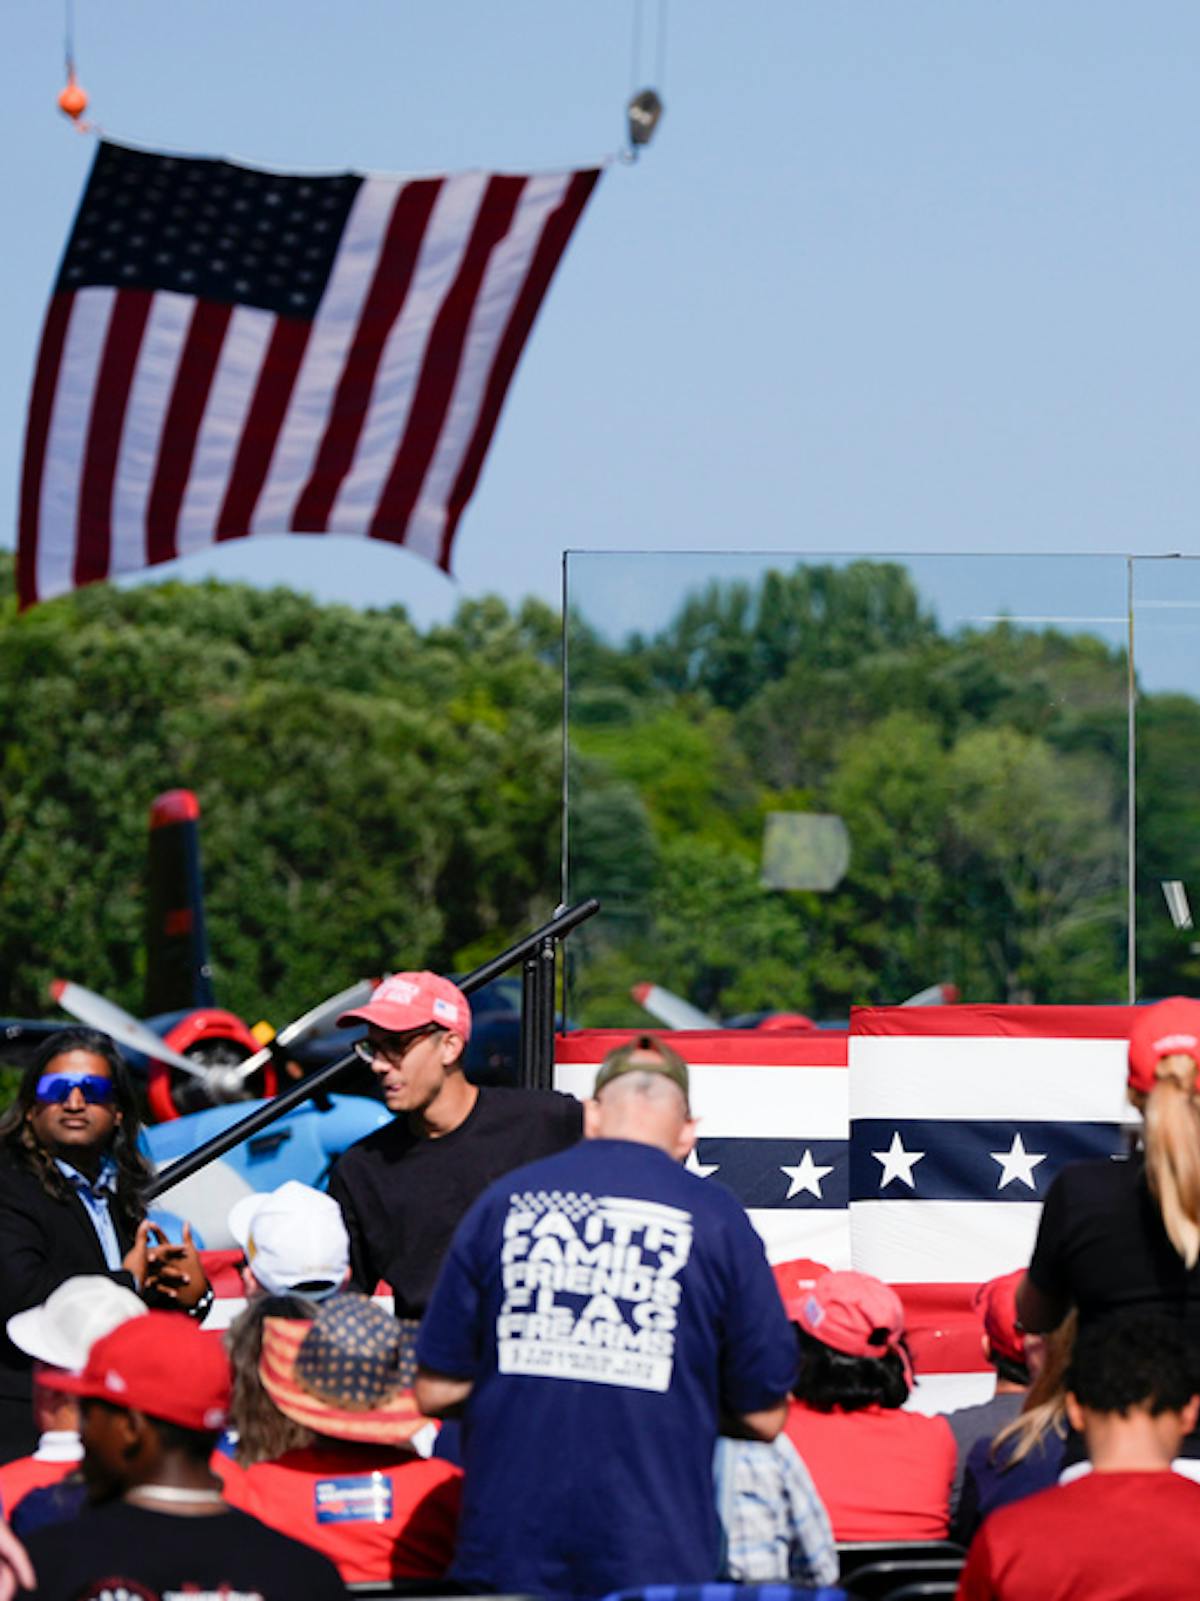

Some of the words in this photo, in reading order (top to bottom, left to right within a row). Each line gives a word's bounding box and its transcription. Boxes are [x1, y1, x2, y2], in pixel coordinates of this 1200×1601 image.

[503, 1210, 692, 1253] FAITH
[502, 1235, 691, 1280] FAMILY
[503, 1261, 683, 1308] FRIENDS
[501, 1286, 678, 1332] FLAG
